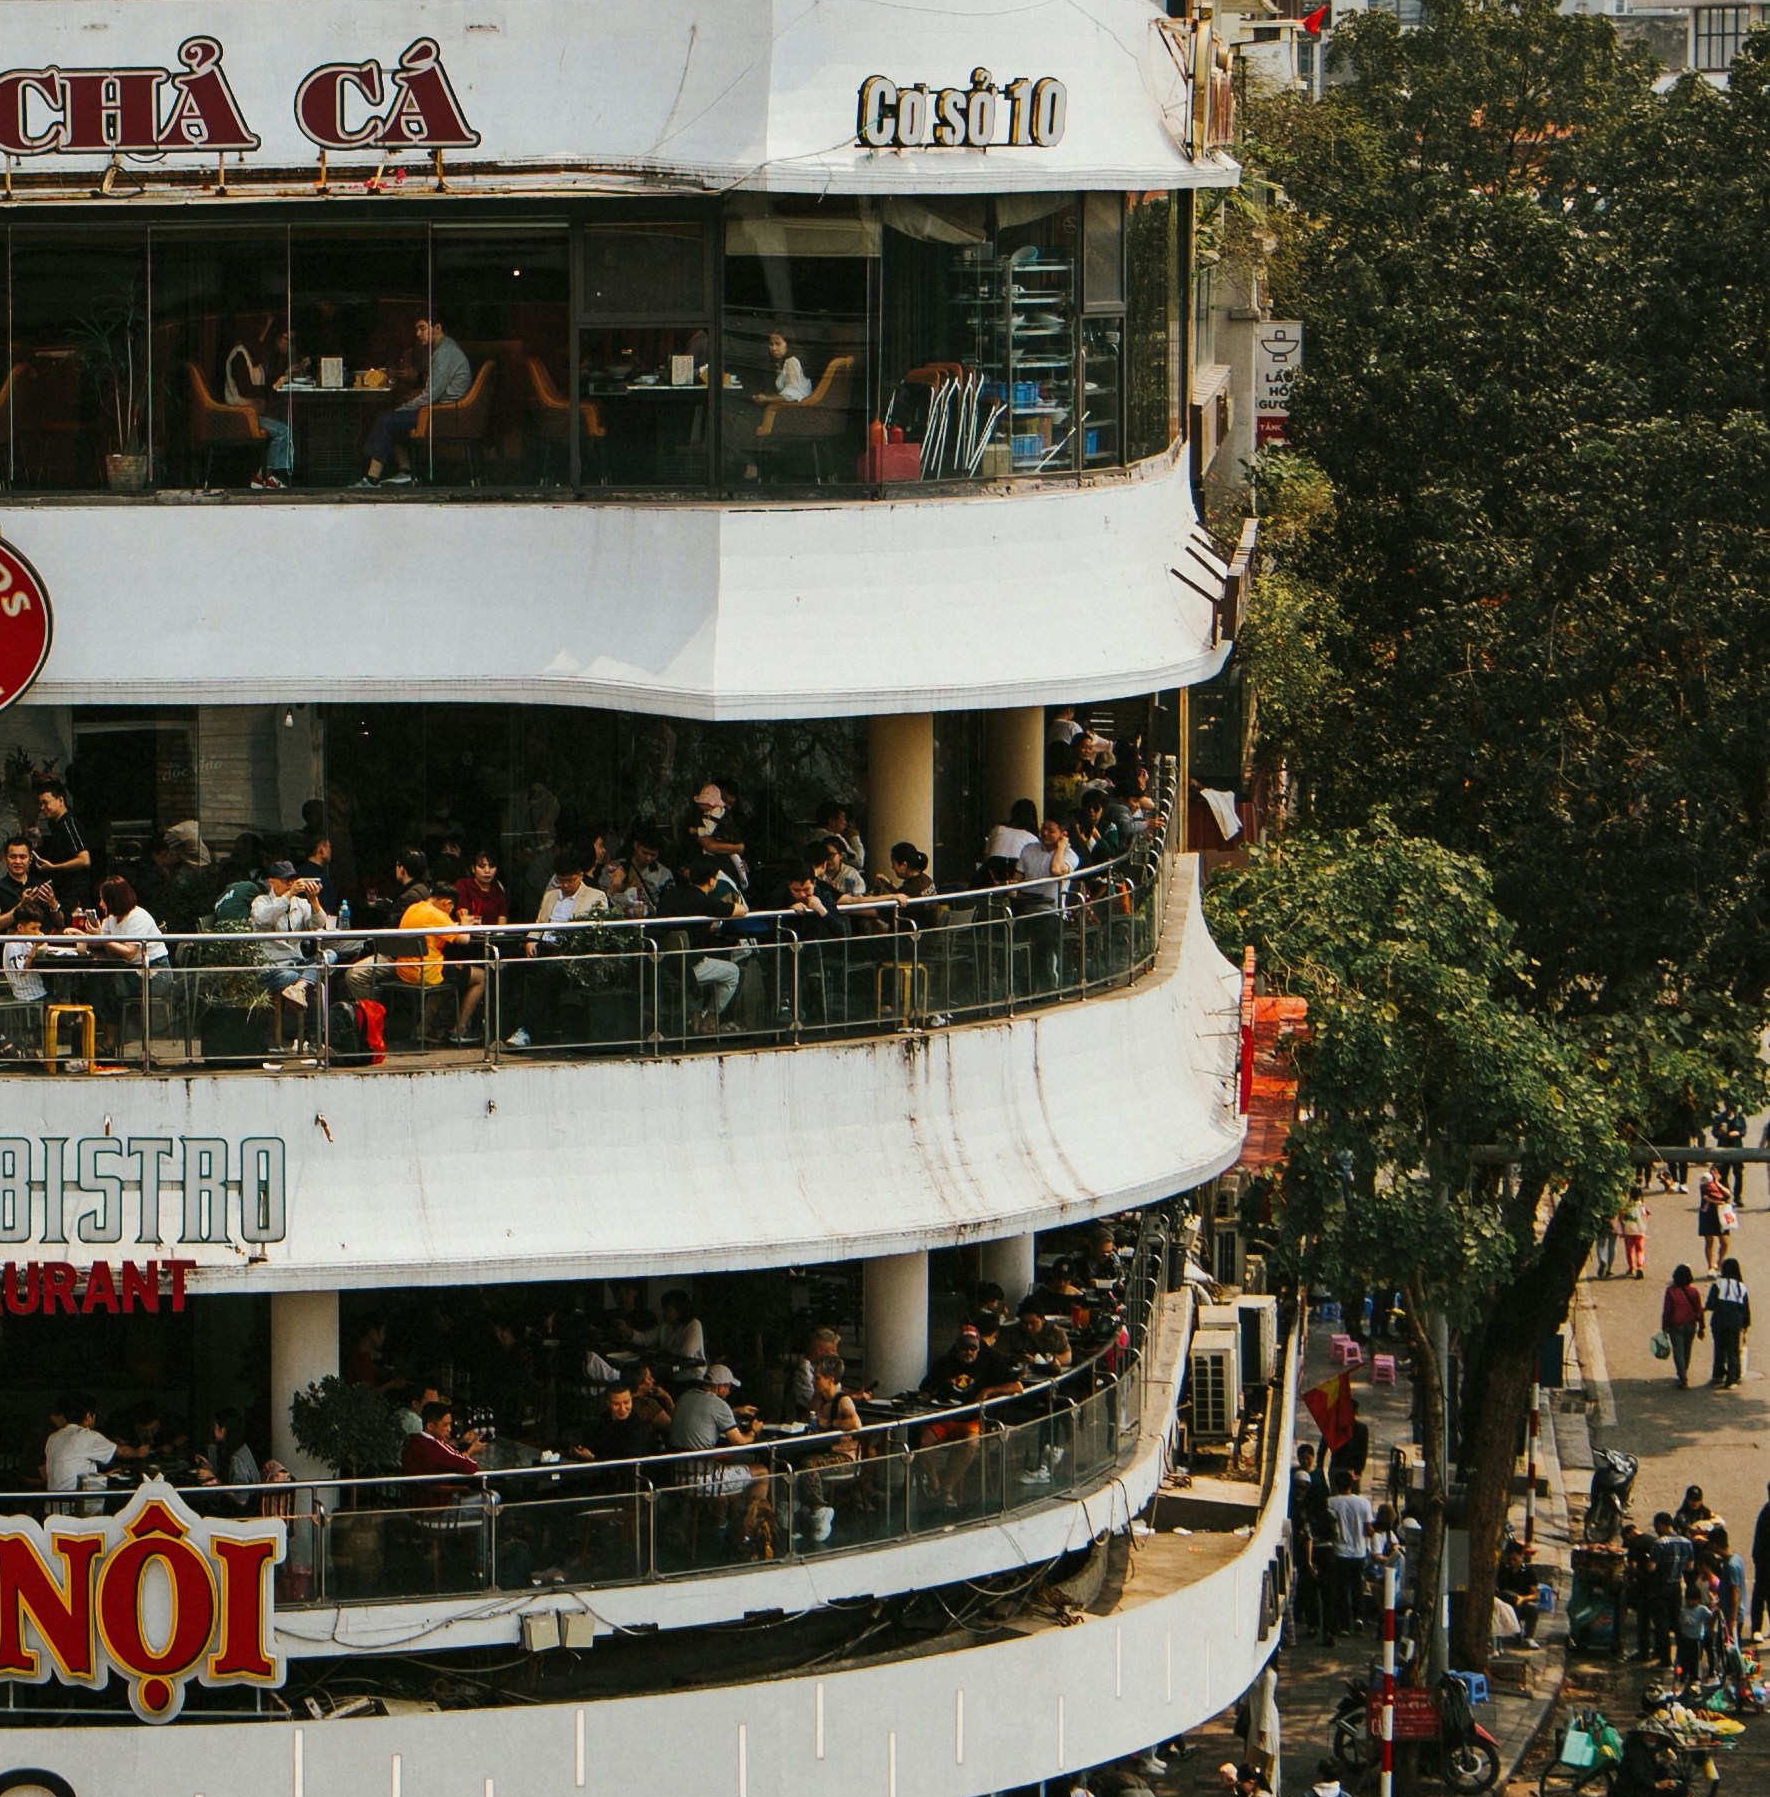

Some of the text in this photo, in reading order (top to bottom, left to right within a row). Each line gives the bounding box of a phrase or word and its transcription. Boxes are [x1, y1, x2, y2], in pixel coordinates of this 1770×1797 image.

[294, 37, 482, 150] CÁ
[857, 66, 1068, 147] Cơ sở 10
